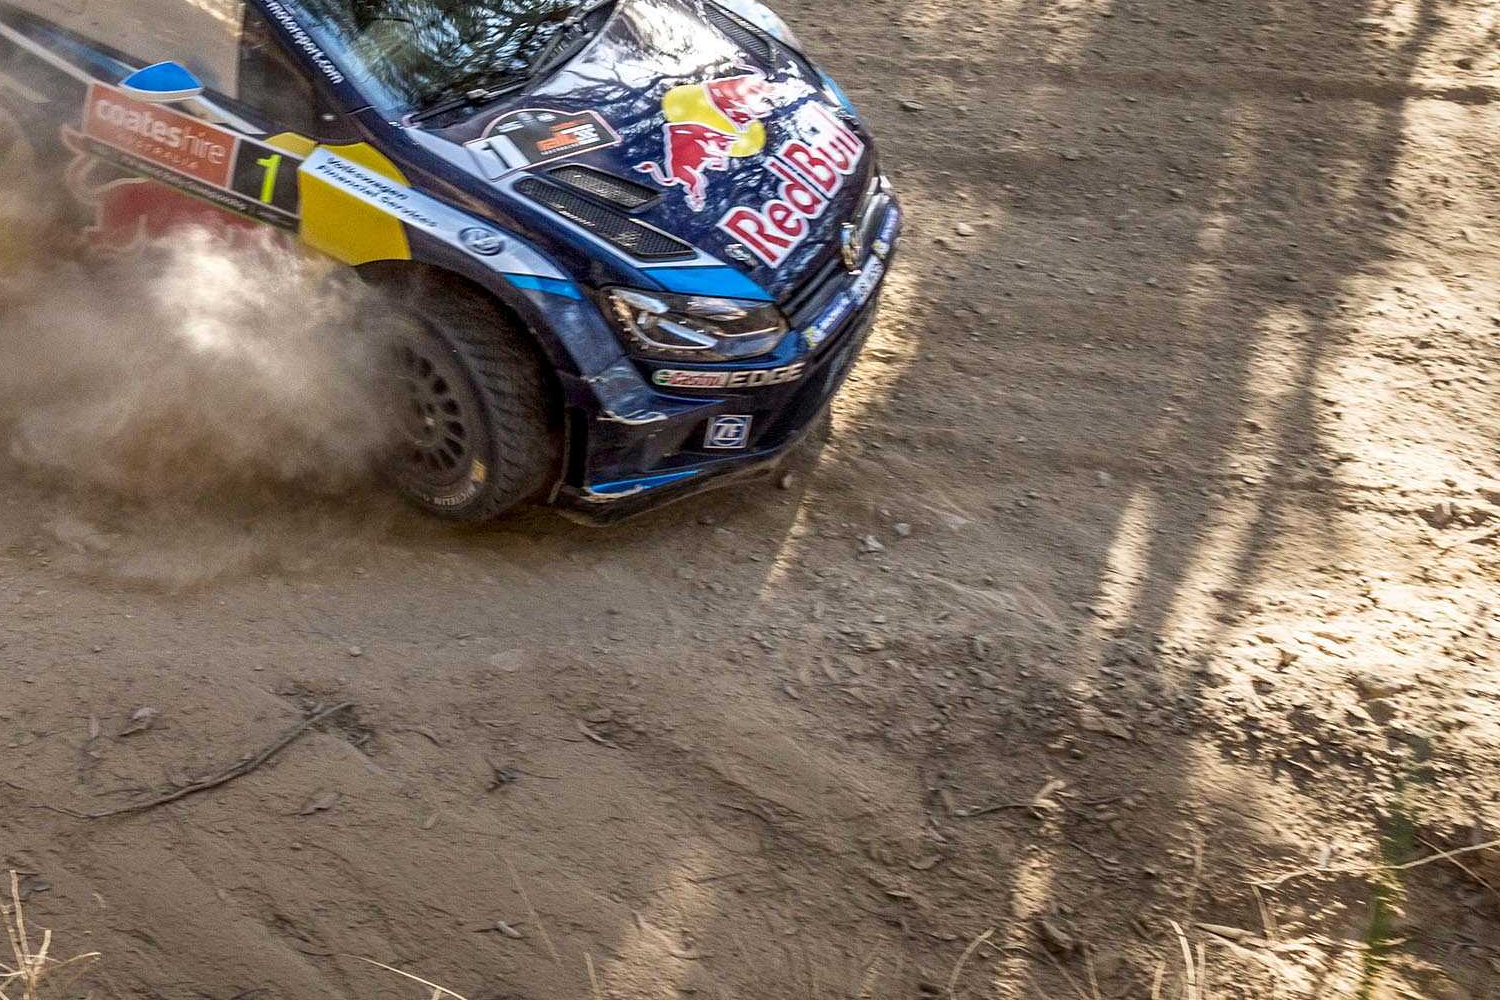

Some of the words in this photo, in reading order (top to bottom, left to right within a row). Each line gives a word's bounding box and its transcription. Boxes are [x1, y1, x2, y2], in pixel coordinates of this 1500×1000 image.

[256, 153, 282, 205] 1
[315, 164, 379, 198] Financial
[379, 195, 439, 228] Services
[327, 156, 409, 201] Volkswagen
[724, 160, 821, 263] Red
[782, 104, 860, 192] Bull
[728, 362, 806, 388] EDGE
